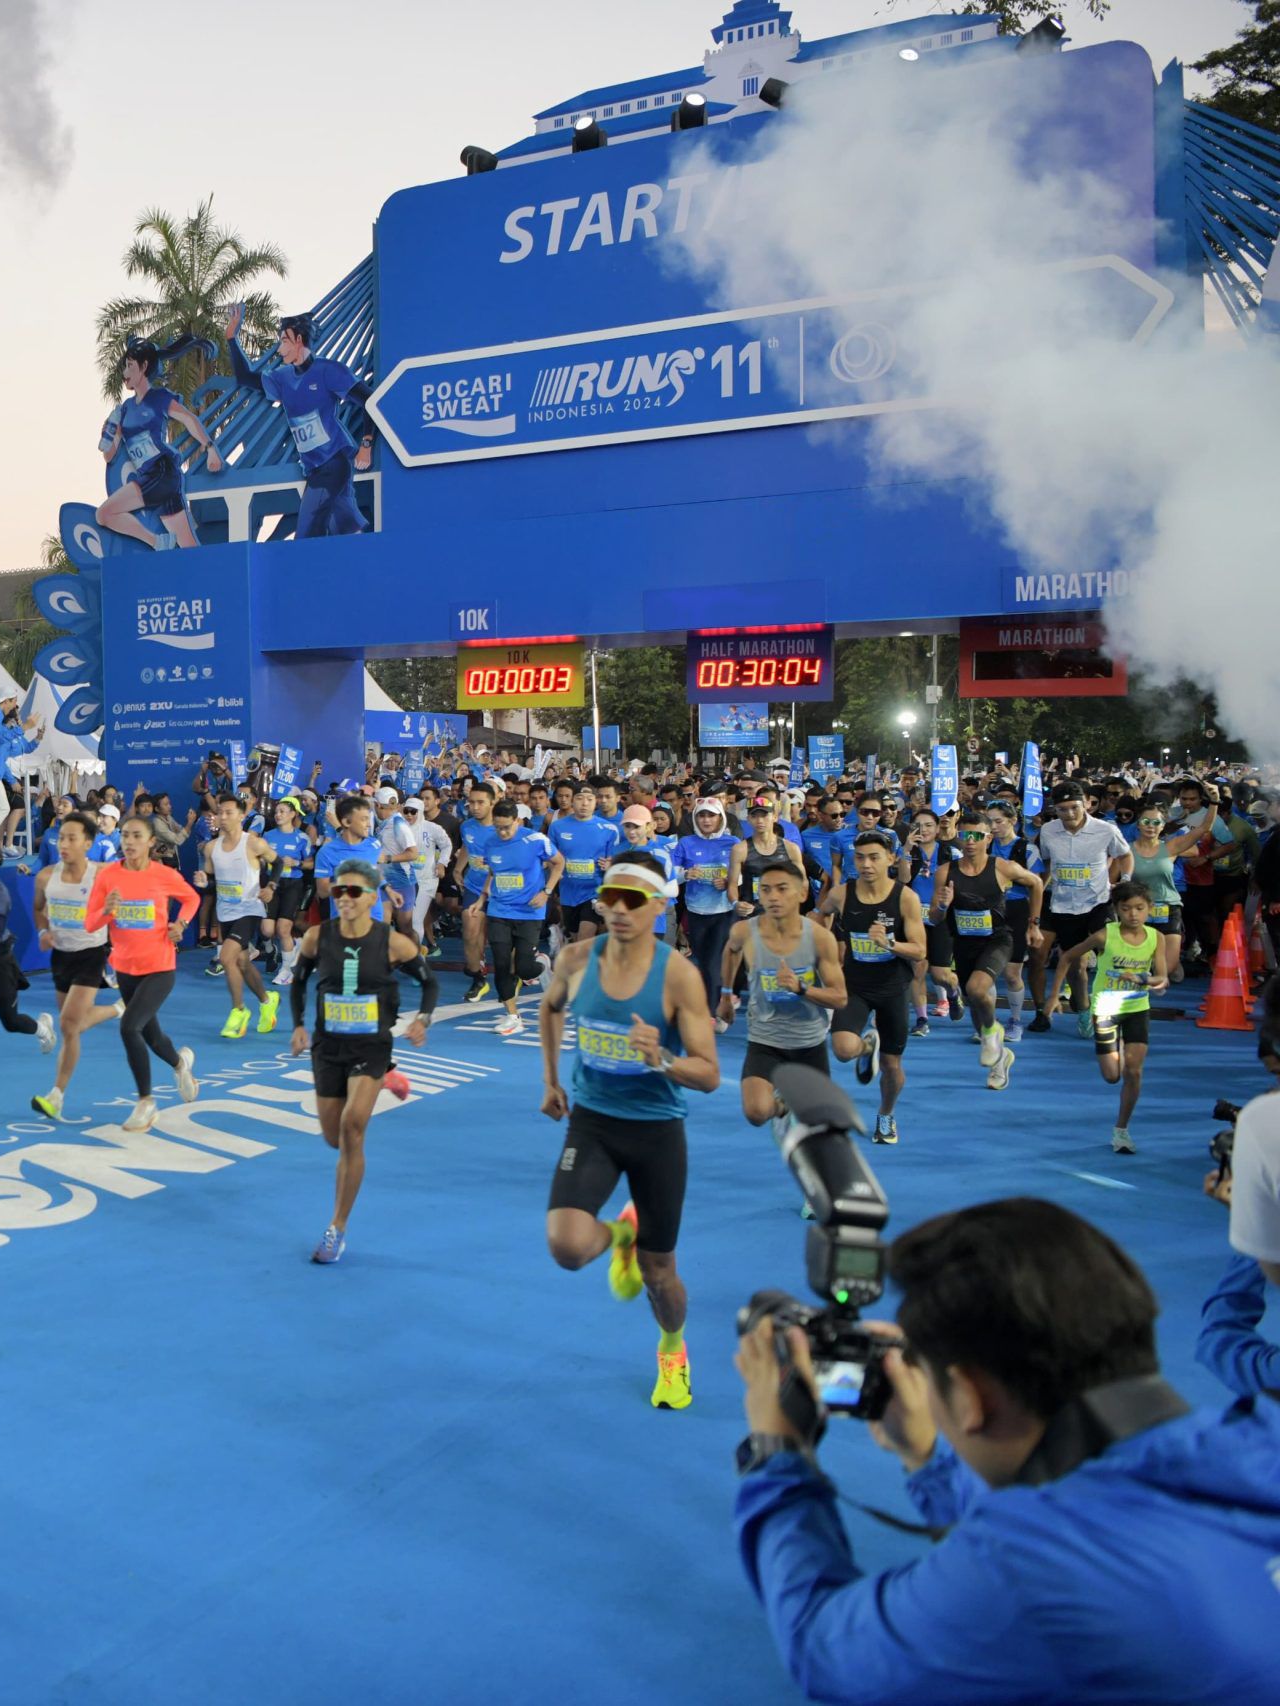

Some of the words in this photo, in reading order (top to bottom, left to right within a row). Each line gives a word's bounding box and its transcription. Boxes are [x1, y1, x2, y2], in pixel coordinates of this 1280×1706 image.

[422, 373, 512, 403] POCARI
[422, 394, 503, 421] SWEAT
[528, 403, 615, 424] INDONESIA
[624, 397, 662, 412] 2024
[292, 424, 318, 444] 102
[137, 598, 211, 619] POCARI
[458, 608, 489, 631] 10K
[137, 615, 205, 634] SWEAT
[701, 641, 735, 658] HALF
[739, 638, 816, 657] MARATHON
[999, 627, 1086, 647] MARATHON
[468, 666, 571, 695] 00:00:03
[698, 659, 822, 688] 00:30:04
[814, 757, 841, 769] 00:55
